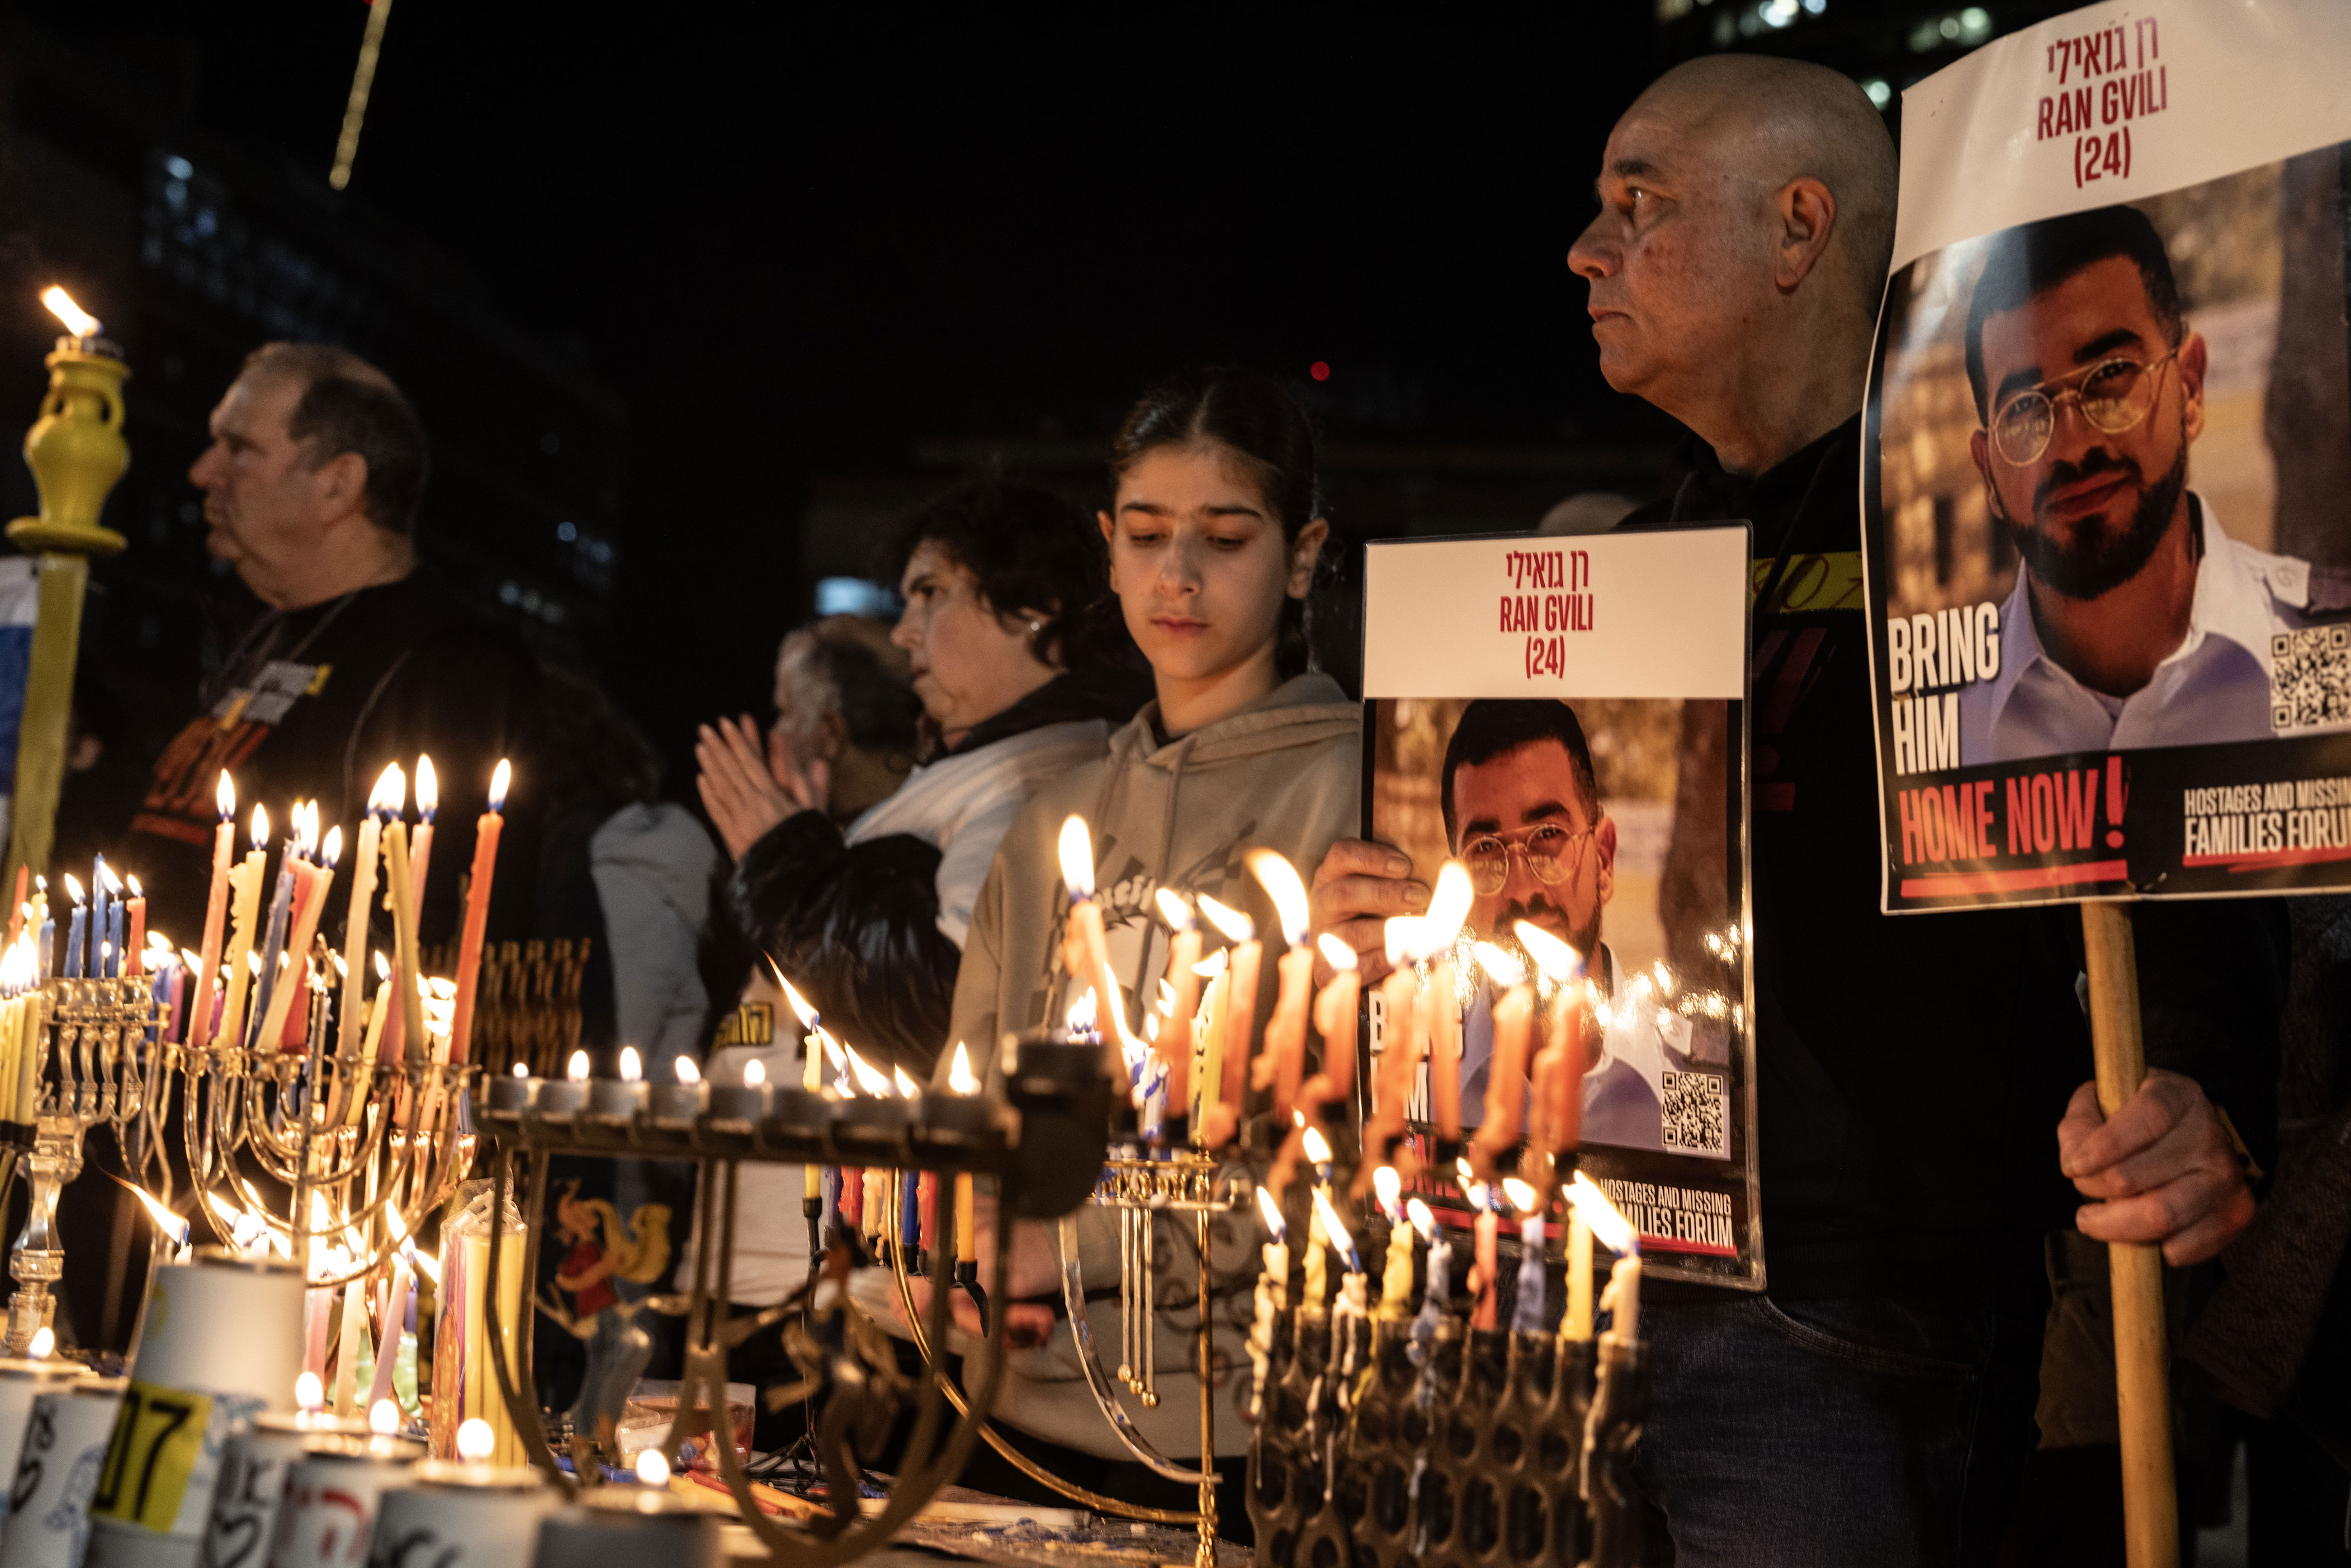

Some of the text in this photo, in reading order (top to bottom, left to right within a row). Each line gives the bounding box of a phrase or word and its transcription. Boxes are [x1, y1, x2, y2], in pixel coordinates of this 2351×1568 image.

[2046, 16, 2159, 85] רן גואילי
[2037, 64, 2167, 140] RAN GVILI
[2074, 125, 2131, 188] (24)
[1506, 549, 1589, 593] רן גואילי
[1499, 593, 1593, 633] RAN GVILI
[1525, 634, 1565, 680] (24)
[1887, 601, 2000, 694] BRING
[1891, 692, 1960, 776] HIM
[1899, 755, 2126, 865] HOME NOW!
[2183, 784, 2262, 817] HOSTAGES
[2264, 781, 2294, 811] AND
[2184, 807, 2351, 857] FAMILIES FORU
[1600, 1178, 1732, 1218] HOSTAGES AND MISSING
[1675, 1209, 1734, 1249] FORUM
